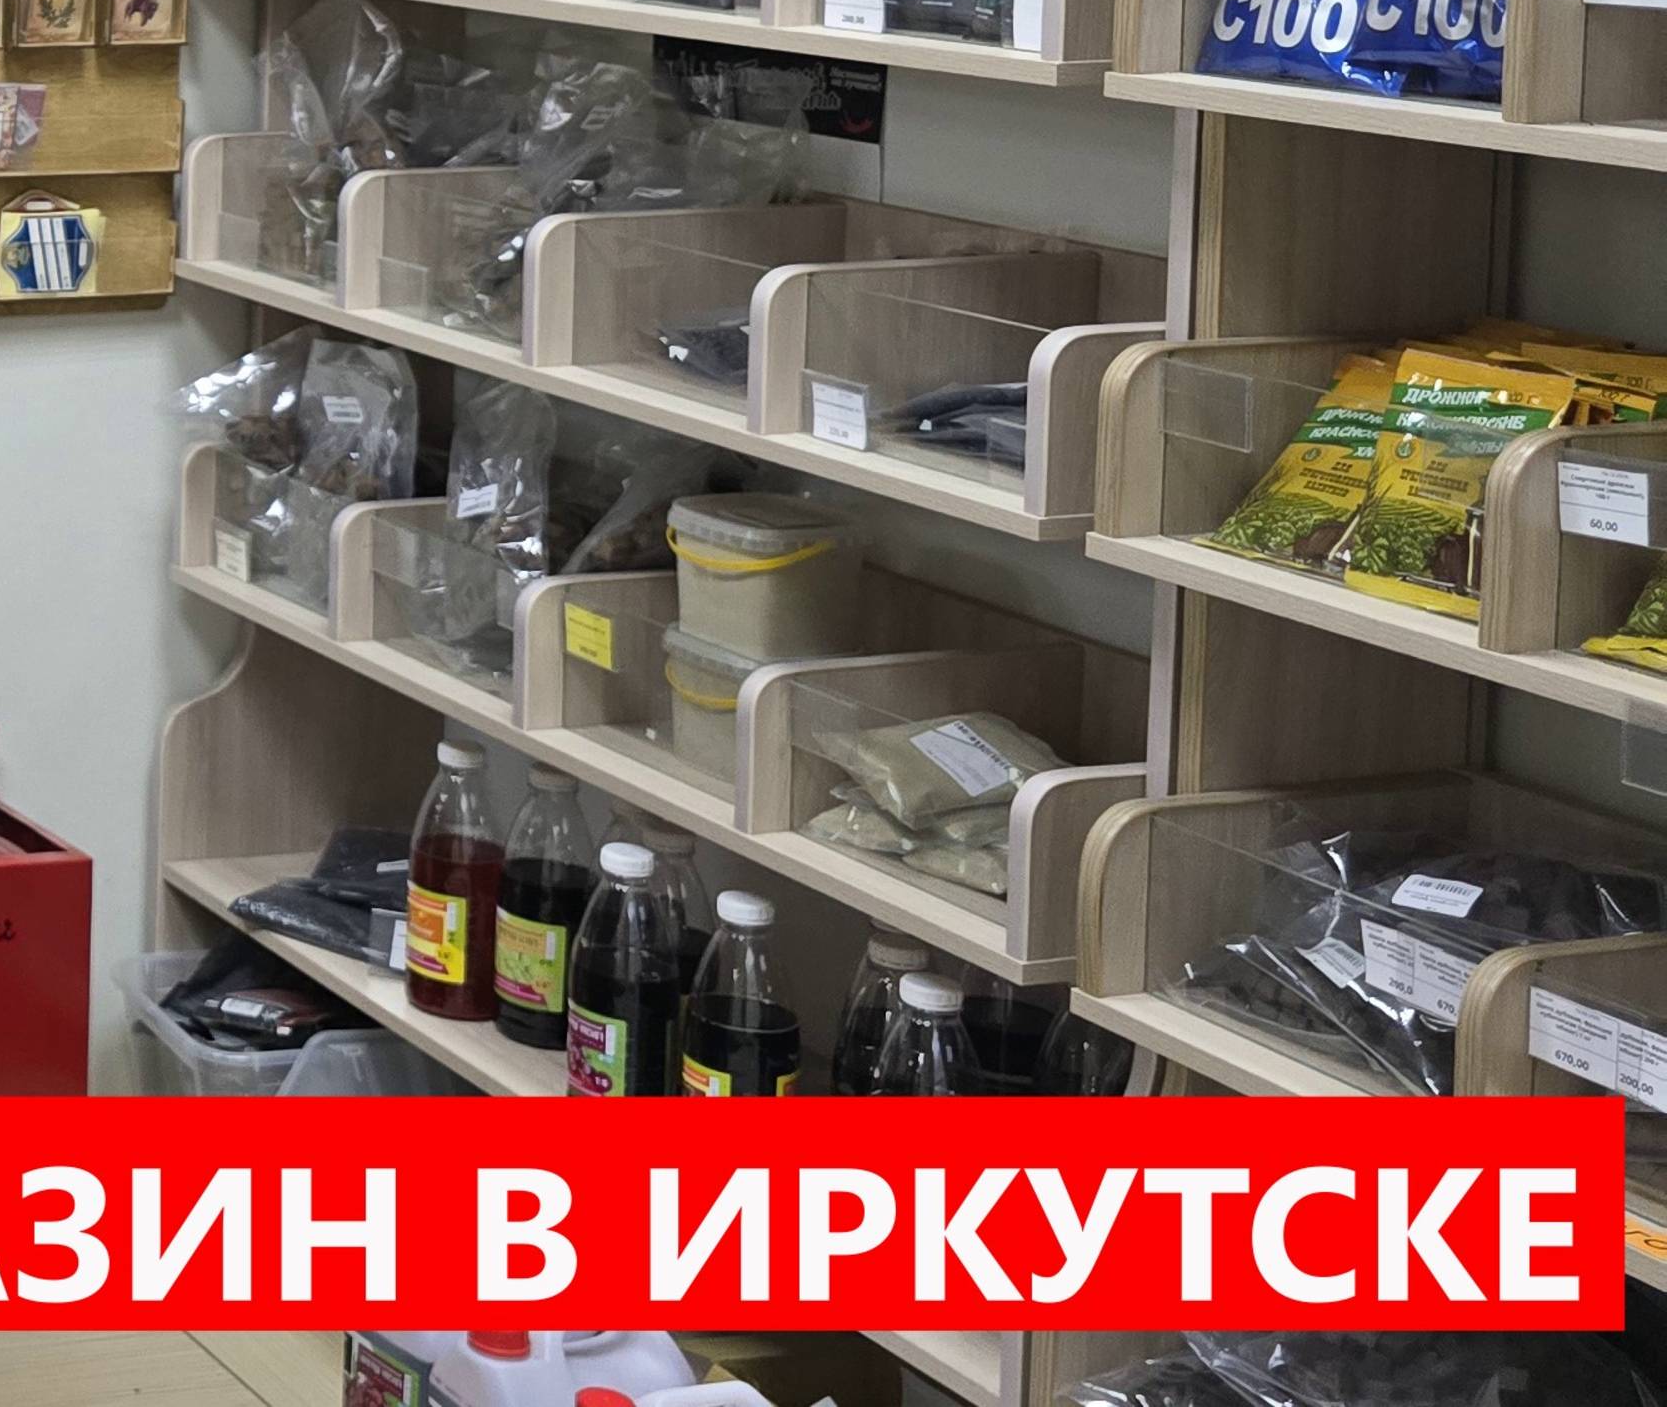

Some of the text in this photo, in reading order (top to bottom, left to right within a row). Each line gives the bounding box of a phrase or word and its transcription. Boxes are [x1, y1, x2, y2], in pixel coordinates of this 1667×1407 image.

[1589, 518, 1618, 532] 60,00
[1555, 1049, 1590, 1071] 670,00
[1619, 1073, 1654, 1096] 200,00
